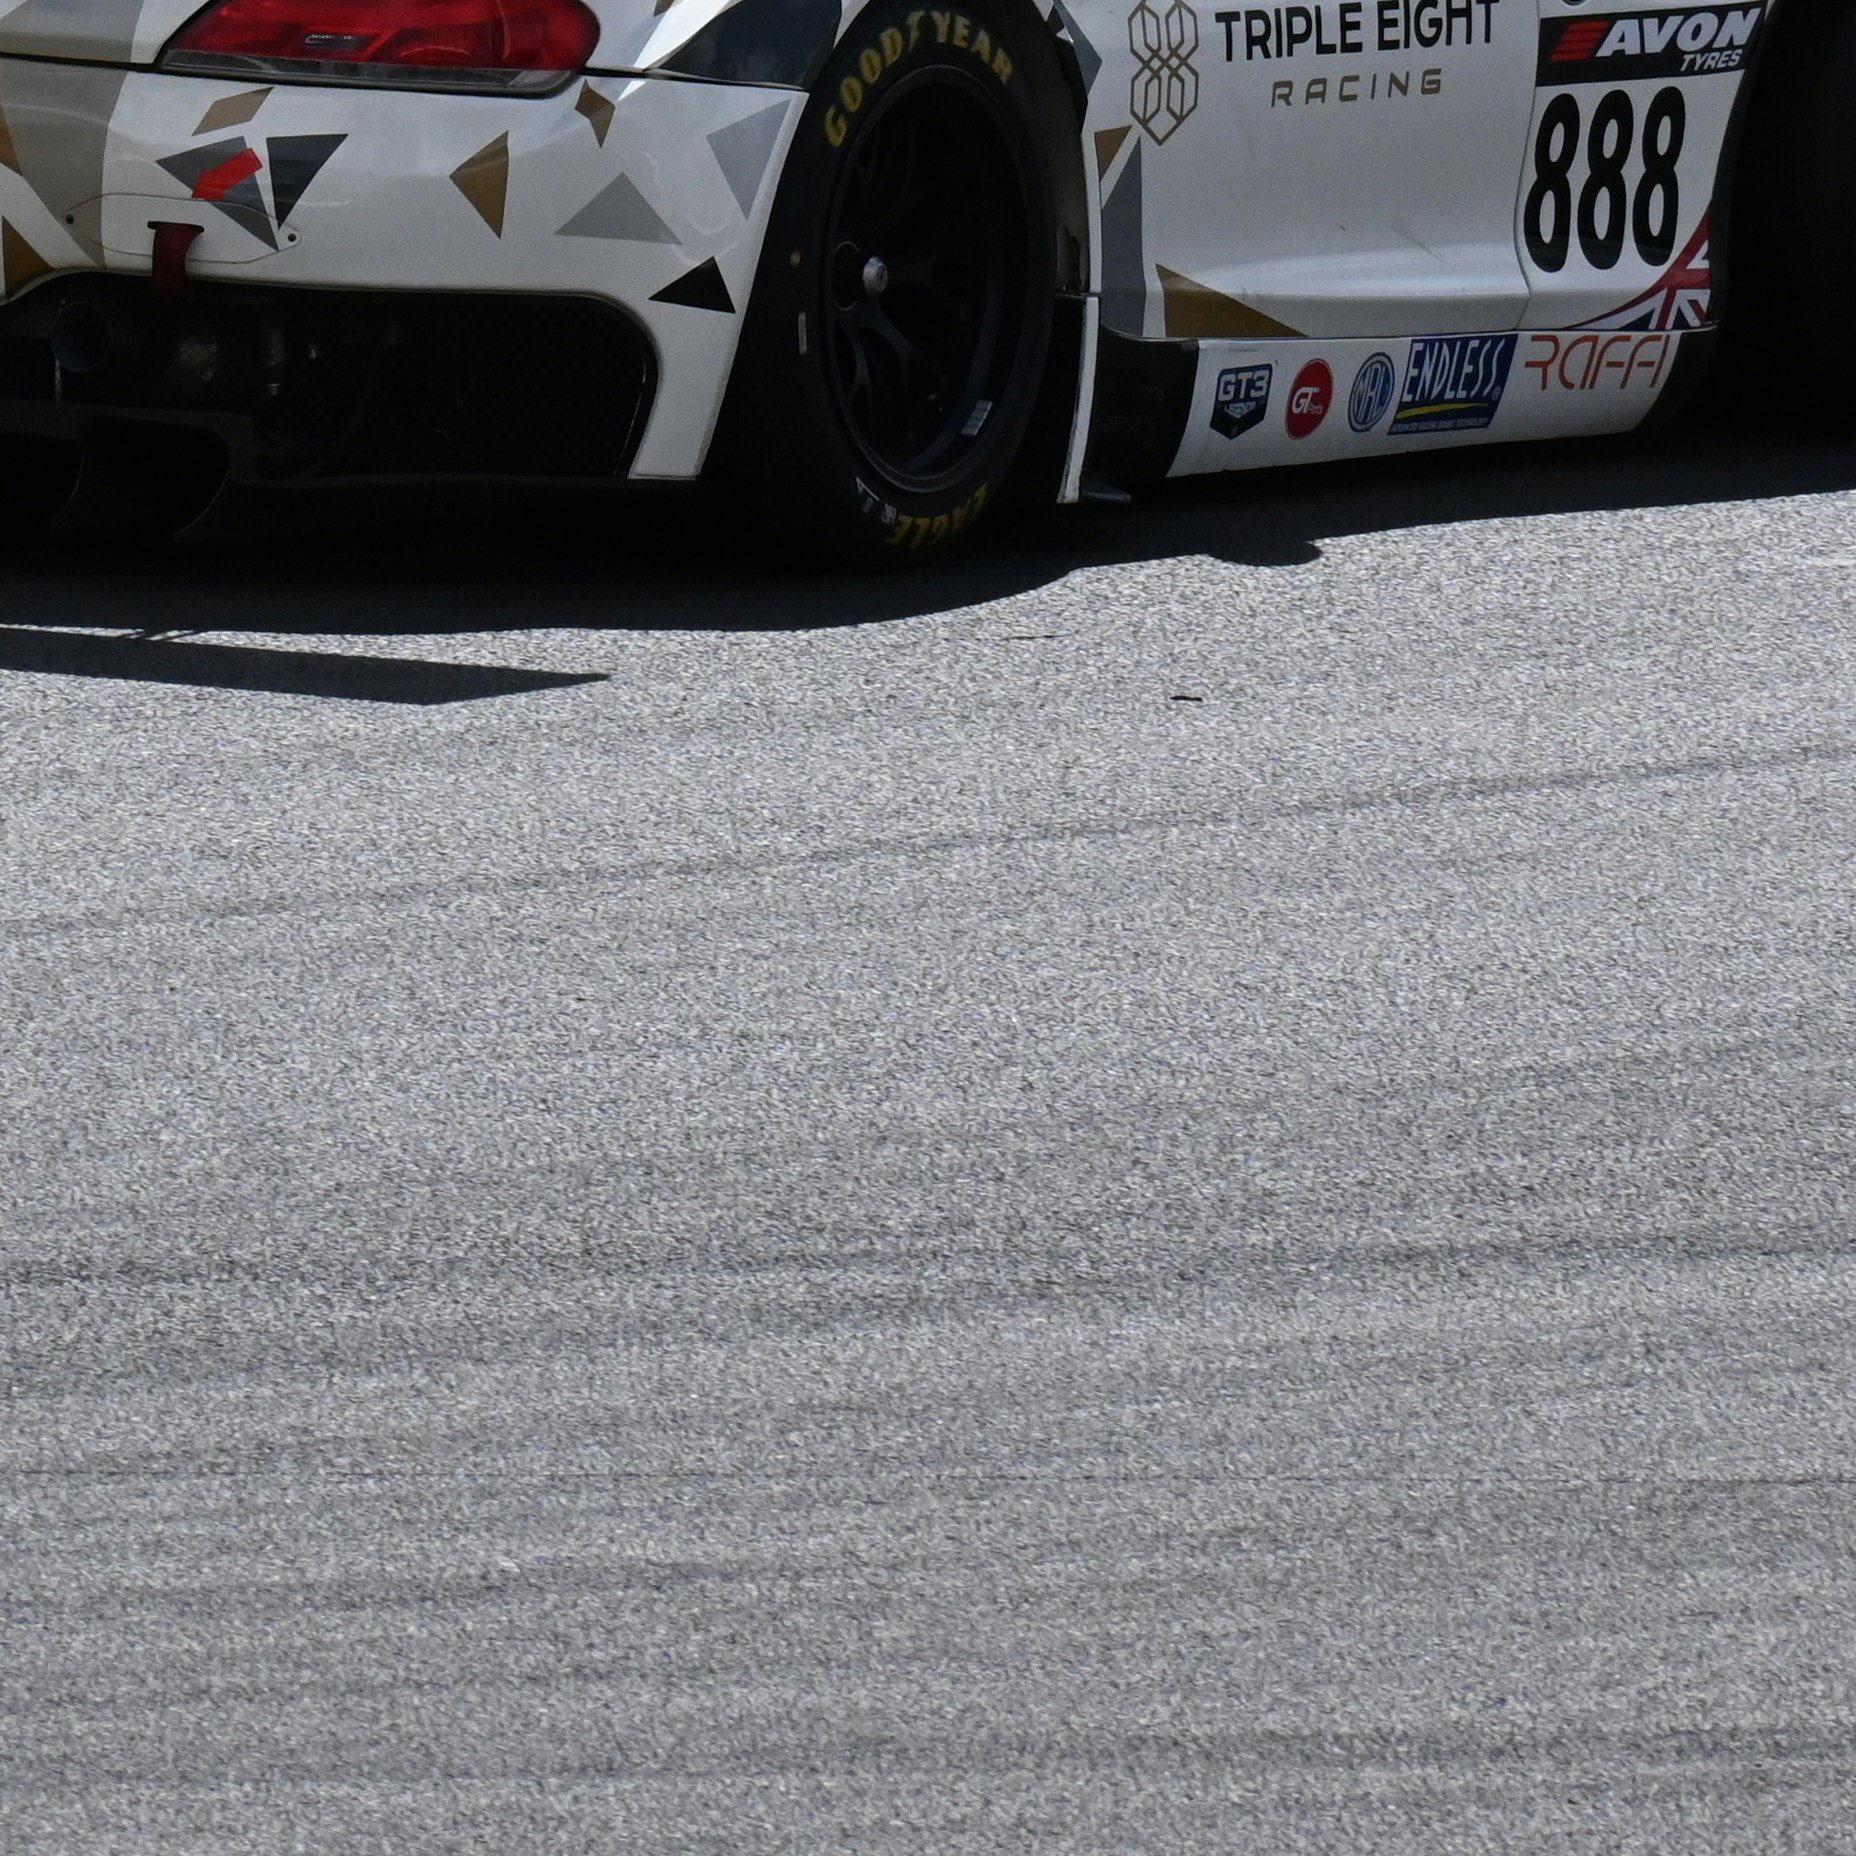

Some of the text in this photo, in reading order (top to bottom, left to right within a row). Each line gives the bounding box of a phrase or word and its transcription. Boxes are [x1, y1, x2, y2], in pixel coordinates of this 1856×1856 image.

[1214, 1, 1363, 62] TRIPLE
[1595, 7, 1763, 58] AVON
[1680, 48, 1743, 72] TYRES
[1270, 68, 1442, 108] RACING
[1524, 86, 1686, 273] 888
[1218, 369, 1271, 402] GT3
[1401, 338, 1506, 402] ENDLESS
[1524, 334, 1671, 392] RAFFI
[1291, 386, 1321, 414] GT
